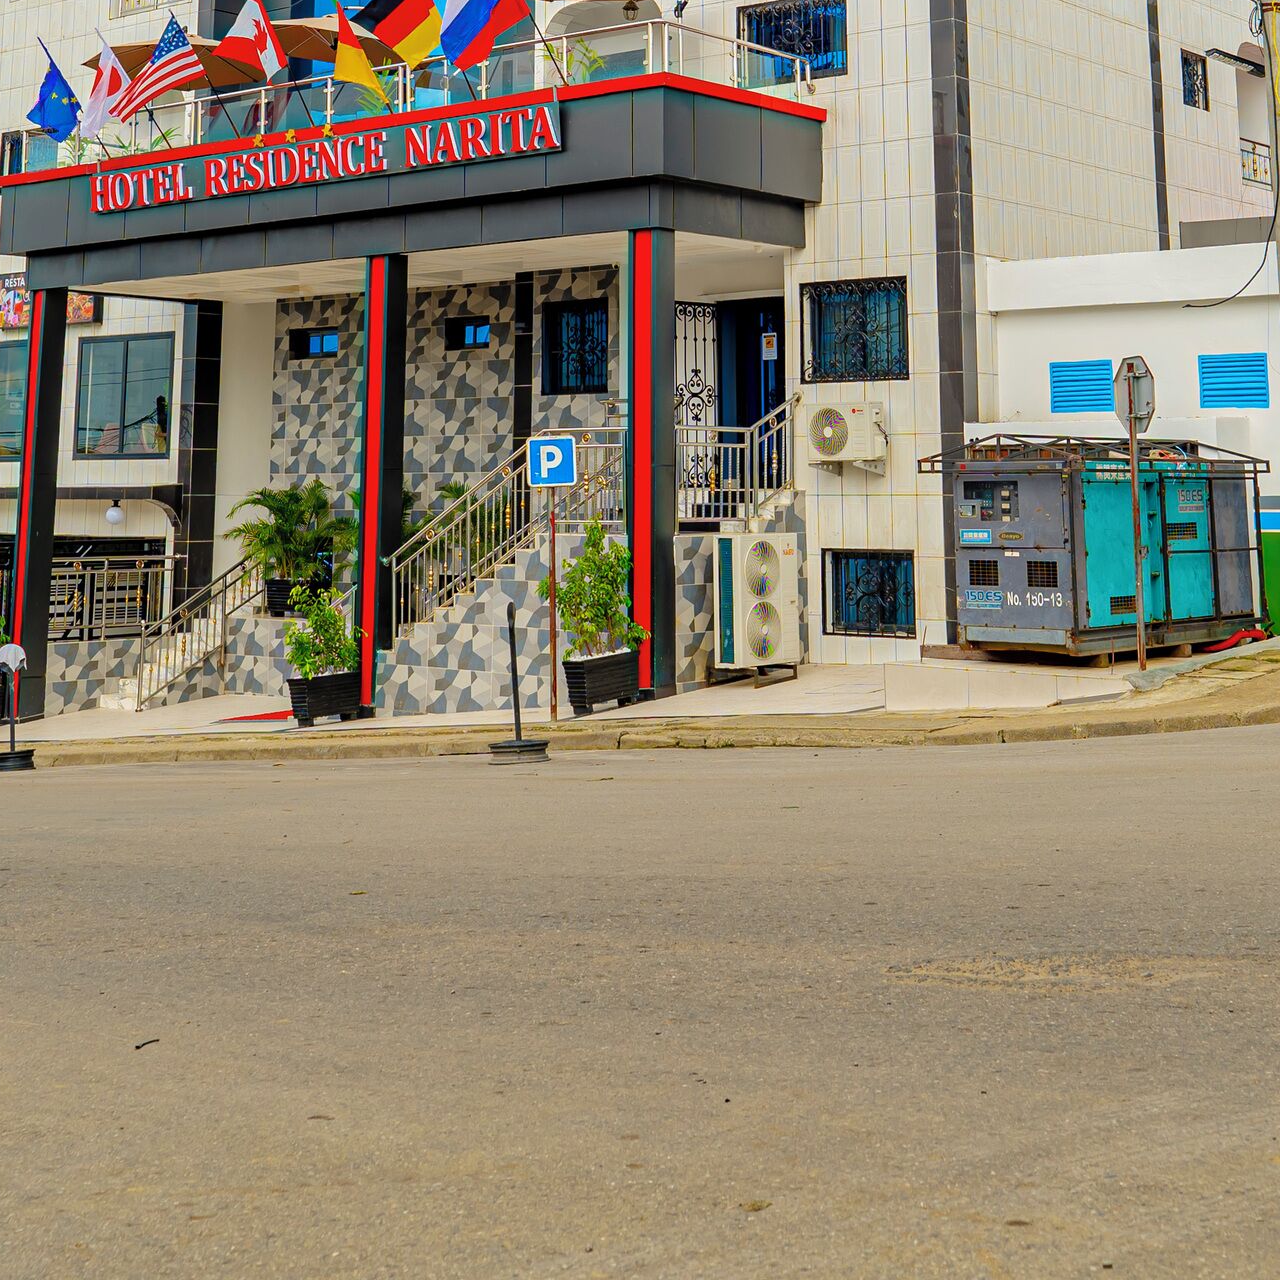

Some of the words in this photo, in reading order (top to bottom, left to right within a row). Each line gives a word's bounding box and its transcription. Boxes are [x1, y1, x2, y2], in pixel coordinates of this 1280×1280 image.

[89, 163, 193, 213] HOTEL
[204, 132, 388, 196] RESIDENCE
[404, 106, 561, 167] NARITA
[4, 277, 26, 288] RESTA
[540, 445, 563, 478] P
[965, 589, 1003, 601] 150ES
[1006, 591, 1022, 607] No.
[1025, 591, 1063, 608] 150-13
